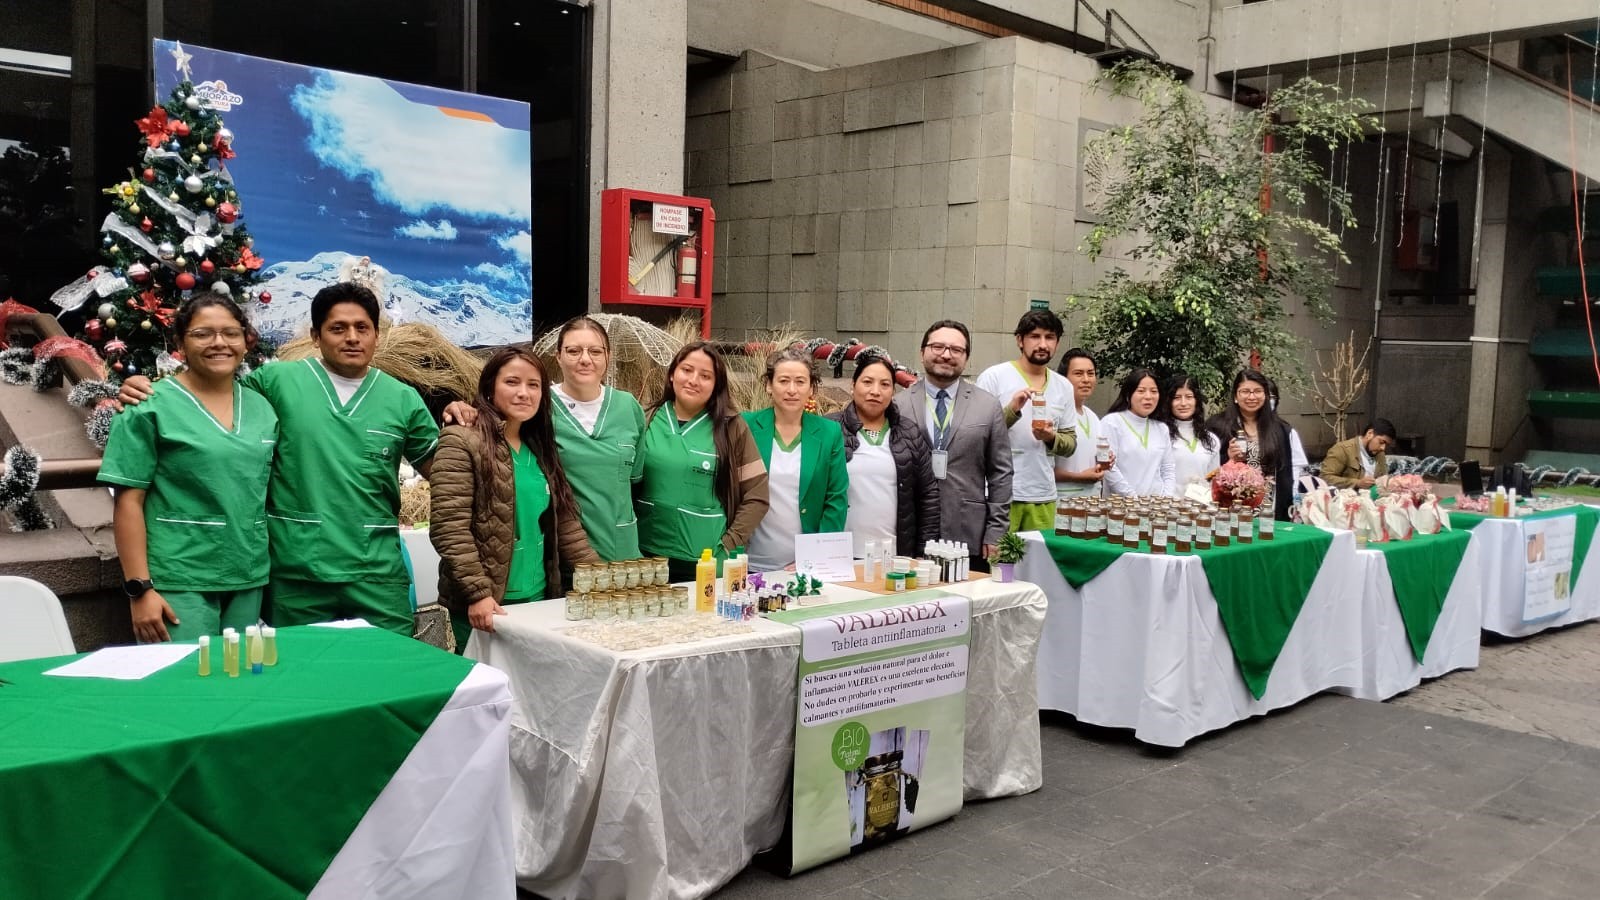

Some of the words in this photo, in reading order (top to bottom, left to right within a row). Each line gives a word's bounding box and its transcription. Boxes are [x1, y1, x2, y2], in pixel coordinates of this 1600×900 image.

[195, 91, 241, 103] MBORAZO
[828, 601, 947, 634] VALEREX
[832, 636, 868, 652] Tableta
[871, 624, 946, 645] antiinflamatoria
[804, 683, 846, 698] inflamación
[847, 675, 879, 689] VALEREX
[888, 672, 901, 680] una
[930, 661, 955, 672] elección
[805, 676, 812, 685] Si
[814, 673, 837, 683] buscas
[839, 670, 852, 678] una
[853, 664, 881, 675] solución
[882, 658, 906, 670] natural
[906, 656, 921, 667] para
[921, 654, 928, 662] el
[928, 651, 945, 660] dolor
[804, 701, 815, 710] No
[816, 697, 837, 708] dudes
[848, 687, 877, 703] probarlo
[883, 679, 924, 694] experimentar
[936, 669, 966, 681] beneficios
[803, 709, 839, 723] calmantes
[840, 707, 845, 715] y
[843, 726, 865, 747] BIO
